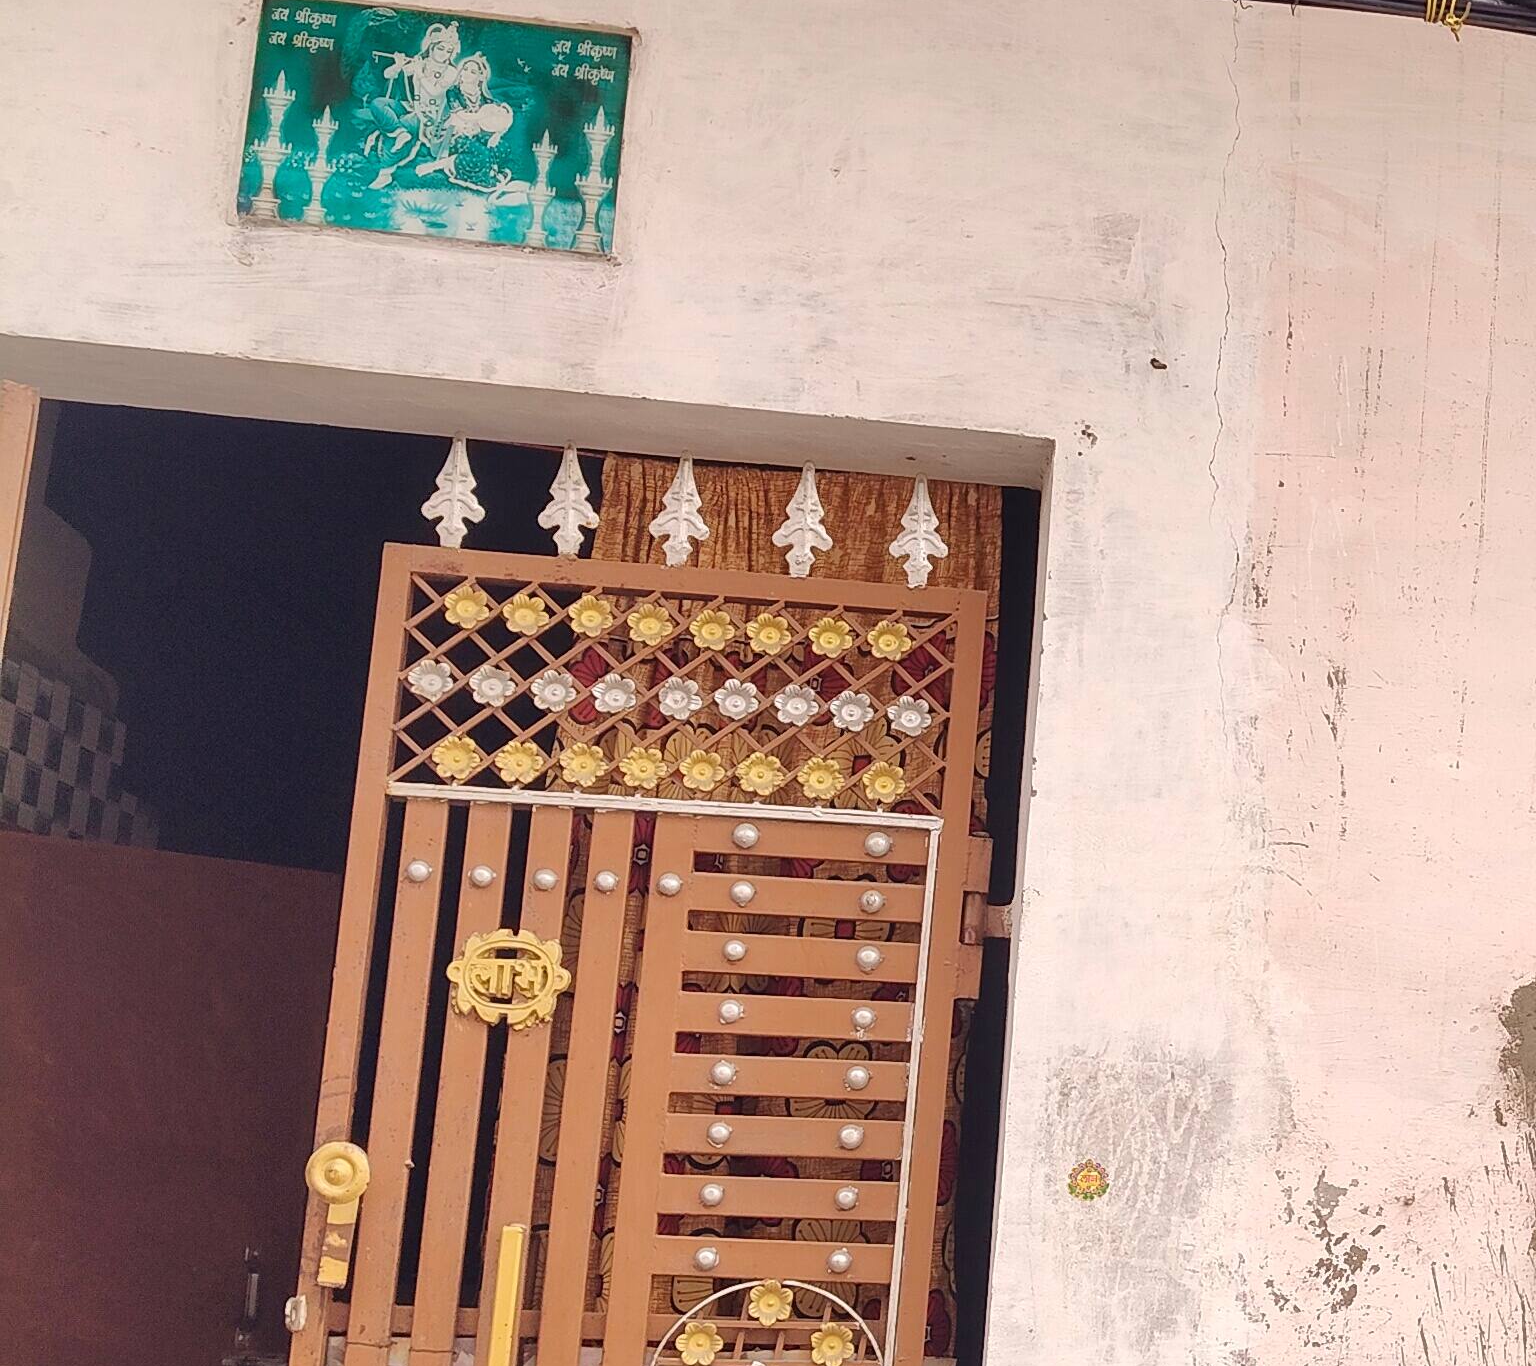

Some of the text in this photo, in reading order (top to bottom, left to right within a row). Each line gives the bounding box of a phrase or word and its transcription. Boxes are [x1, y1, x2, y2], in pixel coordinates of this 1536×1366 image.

[271, 7, 289, 21] जय
[268, 31, 287, 46] जय
[552, 40, 572, 55] जय
[551, 64, 570, 78] जय
[469, 958, 543, 998] लाभ
